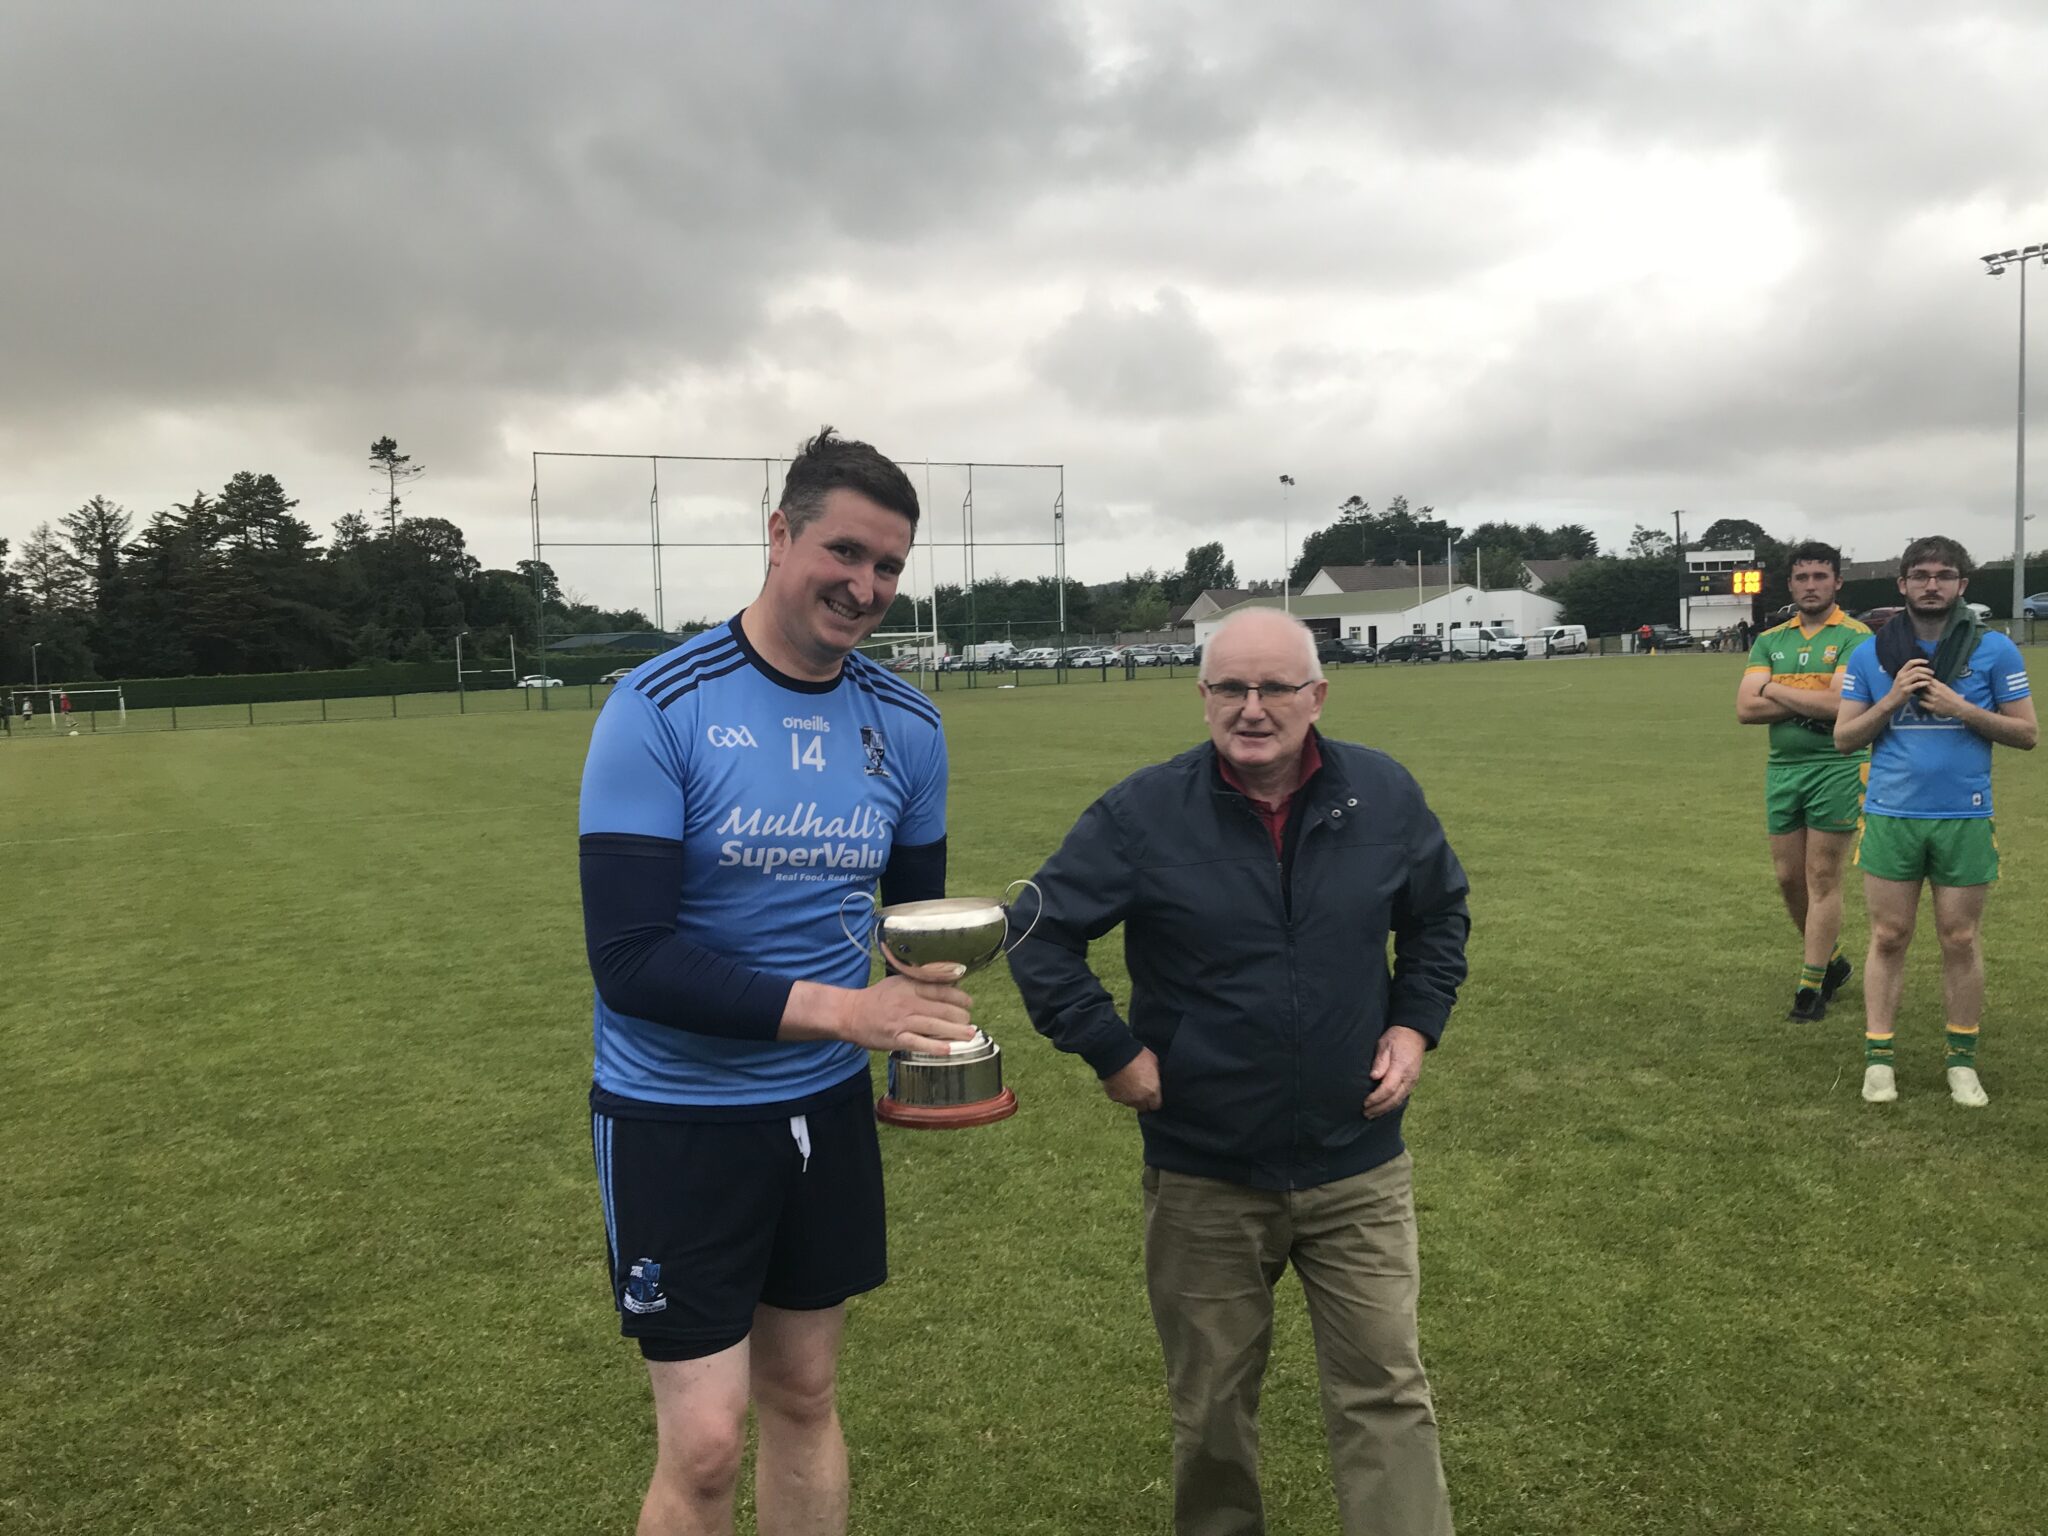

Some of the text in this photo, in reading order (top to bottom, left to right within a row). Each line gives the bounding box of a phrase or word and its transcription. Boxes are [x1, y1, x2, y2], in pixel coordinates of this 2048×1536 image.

[706, 724, 759, 749] GAA
[790, 732, 827, 772] 14
[716, 801, 888, 840] Mulhall's
[718, 840, 884, 875] SuperValu
[775, 872, 797, 881] Real
